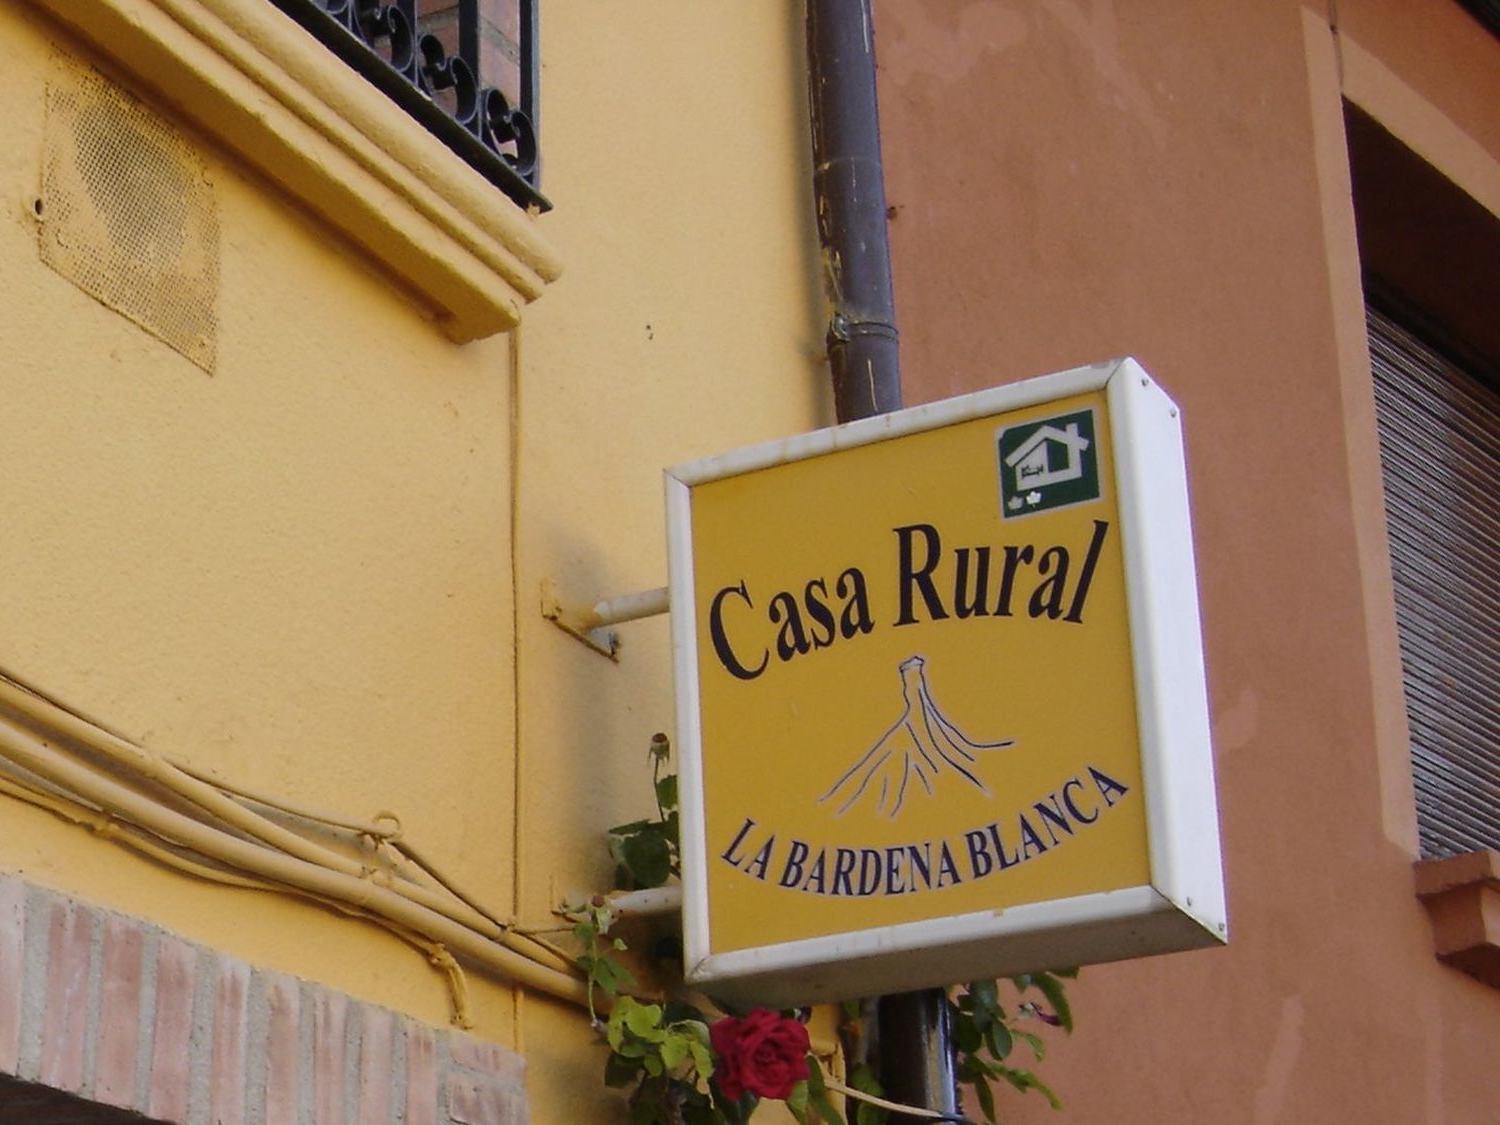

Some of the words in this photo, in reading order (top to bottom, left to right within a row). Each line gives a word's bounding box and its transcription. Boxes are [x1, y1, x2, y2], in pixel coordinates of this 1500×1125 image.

[709, 567, 875, 680] Casa
[892, 520, 1109, 625] Rural
[721, 818, 775, 880] LA
[779, 840, 961, 897] BARDENA
[965, 766, 1129, 879] BLANCA
